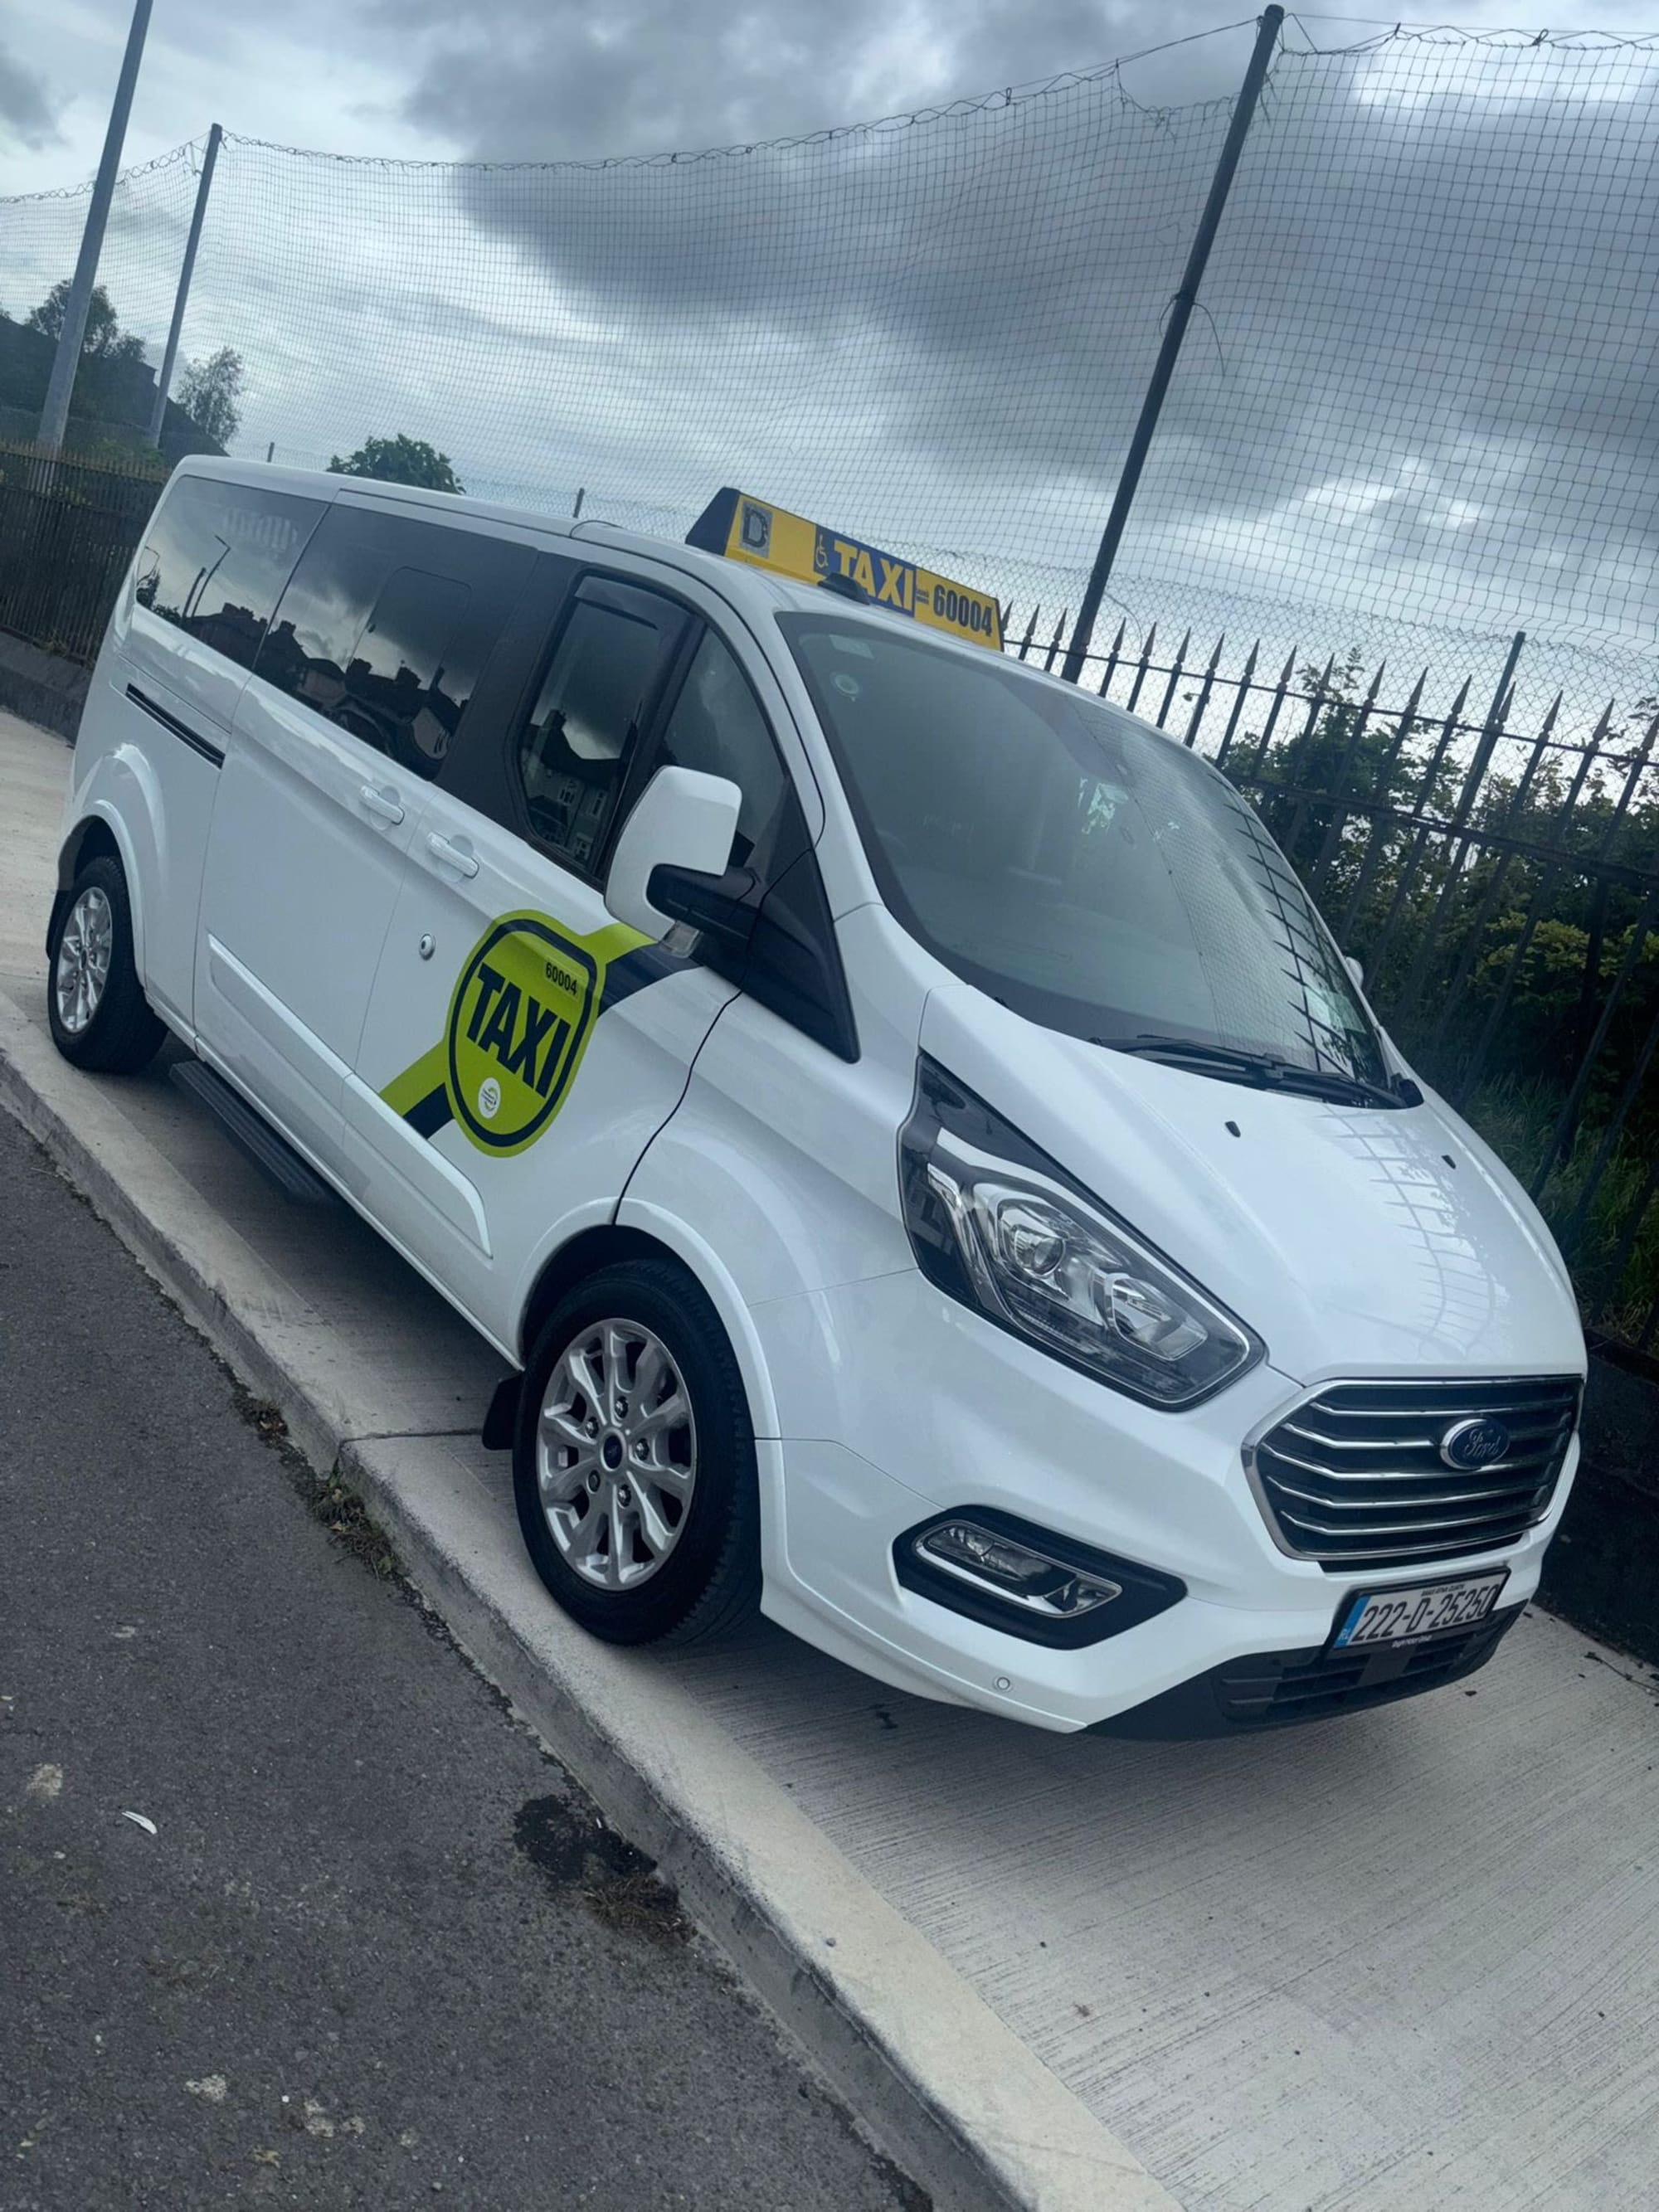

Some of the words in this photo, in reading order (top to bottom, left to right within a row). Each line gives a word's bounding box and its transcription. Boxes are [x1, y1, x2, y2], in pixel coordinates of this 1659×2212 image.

[834, 539, 913, 611] TAXI
[933, 584, 993, 637] 60004
[545, 961, 577, 996] 60004
[466, 962, 572, 1099] TAXI
[1463, 1428, 1501, 1458] Ford
[1350, 1583, 1501, 1642] 222-D-25250
